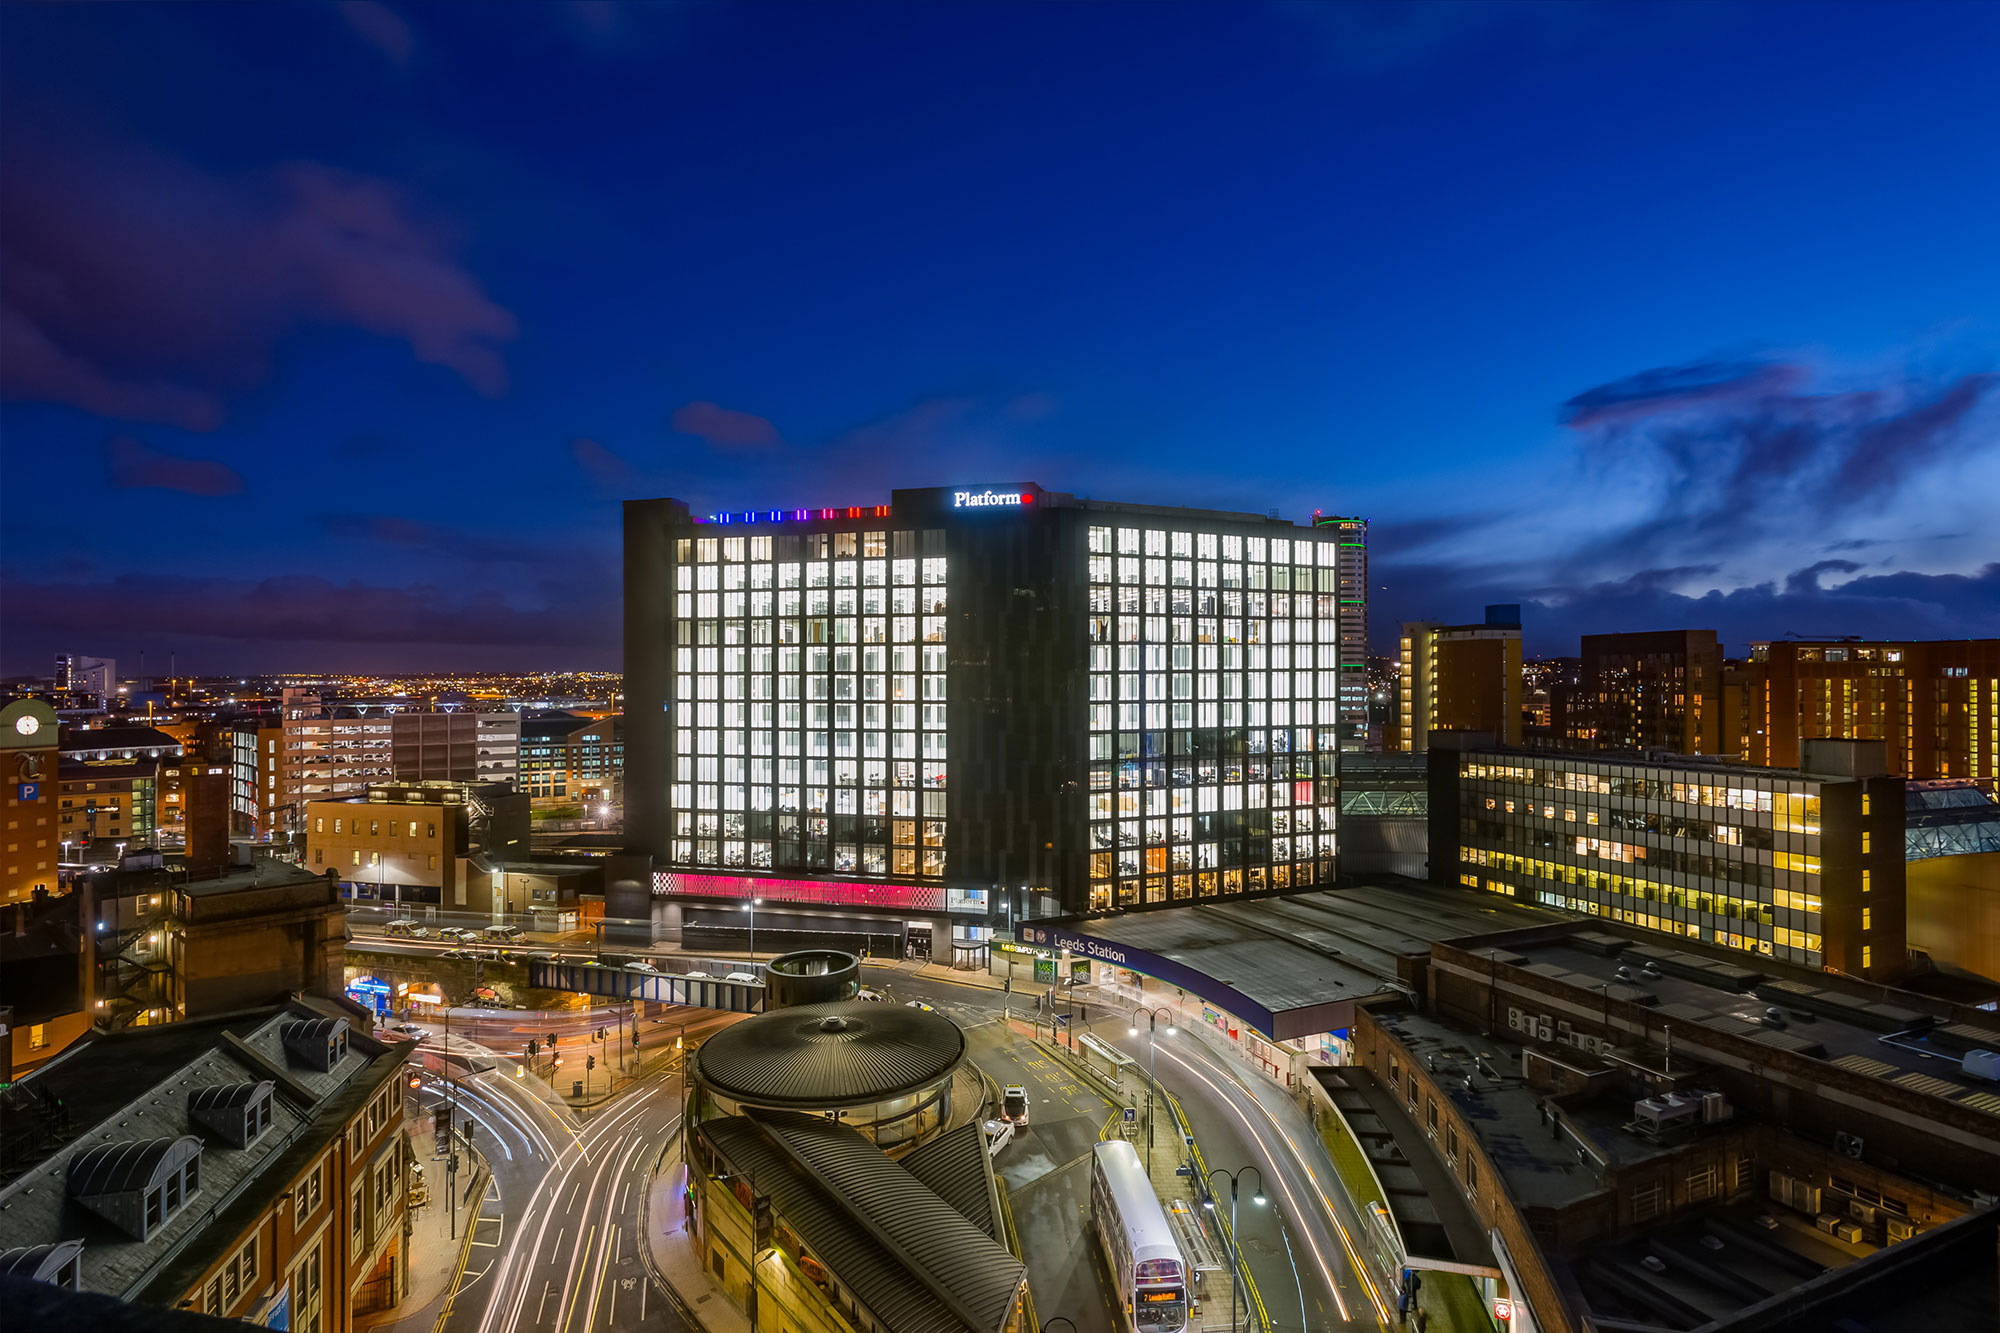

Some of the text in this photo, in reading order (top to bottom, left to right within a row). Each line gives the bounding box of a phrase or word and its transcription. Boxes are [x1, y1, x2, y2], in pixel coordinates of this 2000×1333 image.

[954, 490, 1022, 507] Platform
[24, 786, 34, 799] P
[1054, 934, 1125, 963] Leeds Station
